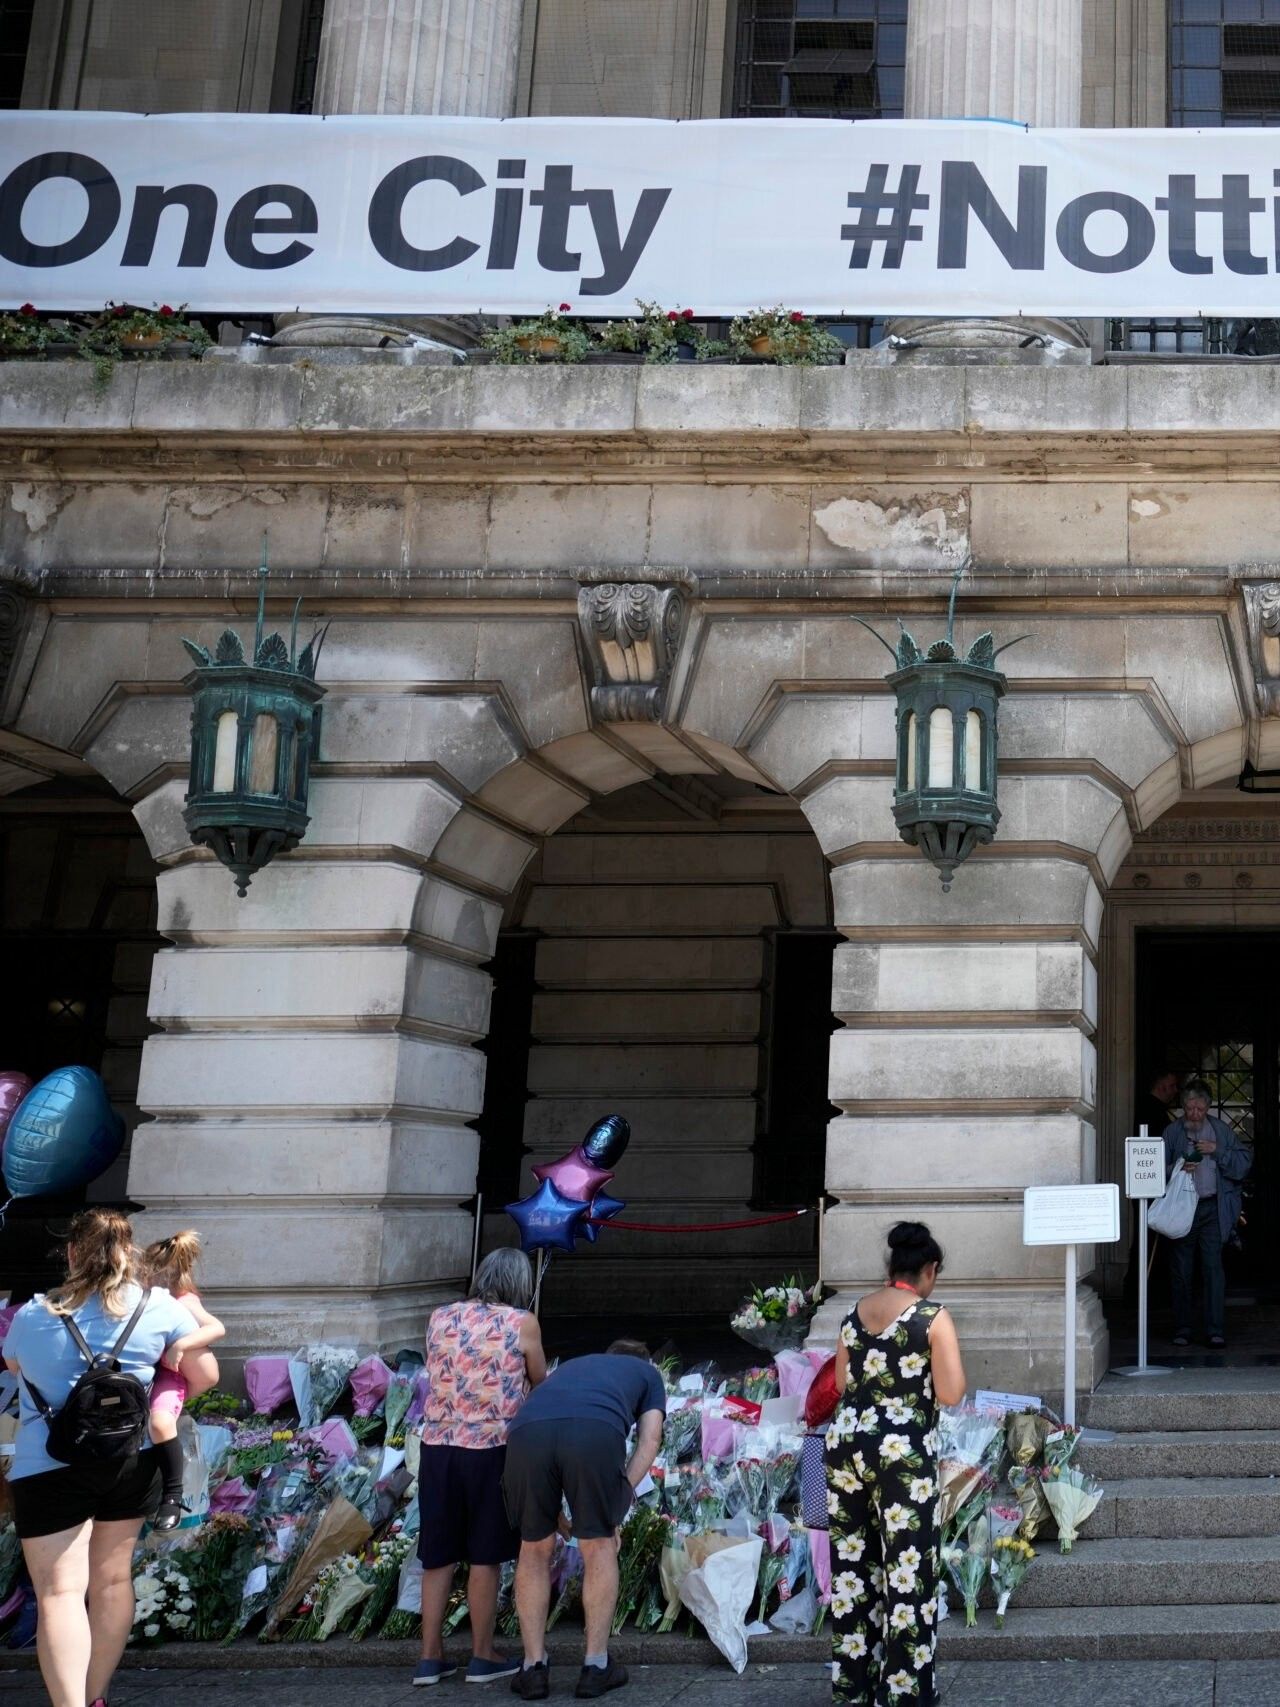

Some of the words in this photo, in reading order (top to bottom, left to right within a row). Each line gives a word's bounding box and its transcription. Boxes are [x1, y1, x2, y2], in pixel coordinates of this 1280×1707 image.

[0, 151, 318, 270] One
[368, 155, 672, 296] City
[1132, 1147, 1158, 1156] PLEASE
[1137, 1160, 1154, 1168] KEEP
[1134, 1172, 1157, 1180] CLEAR
